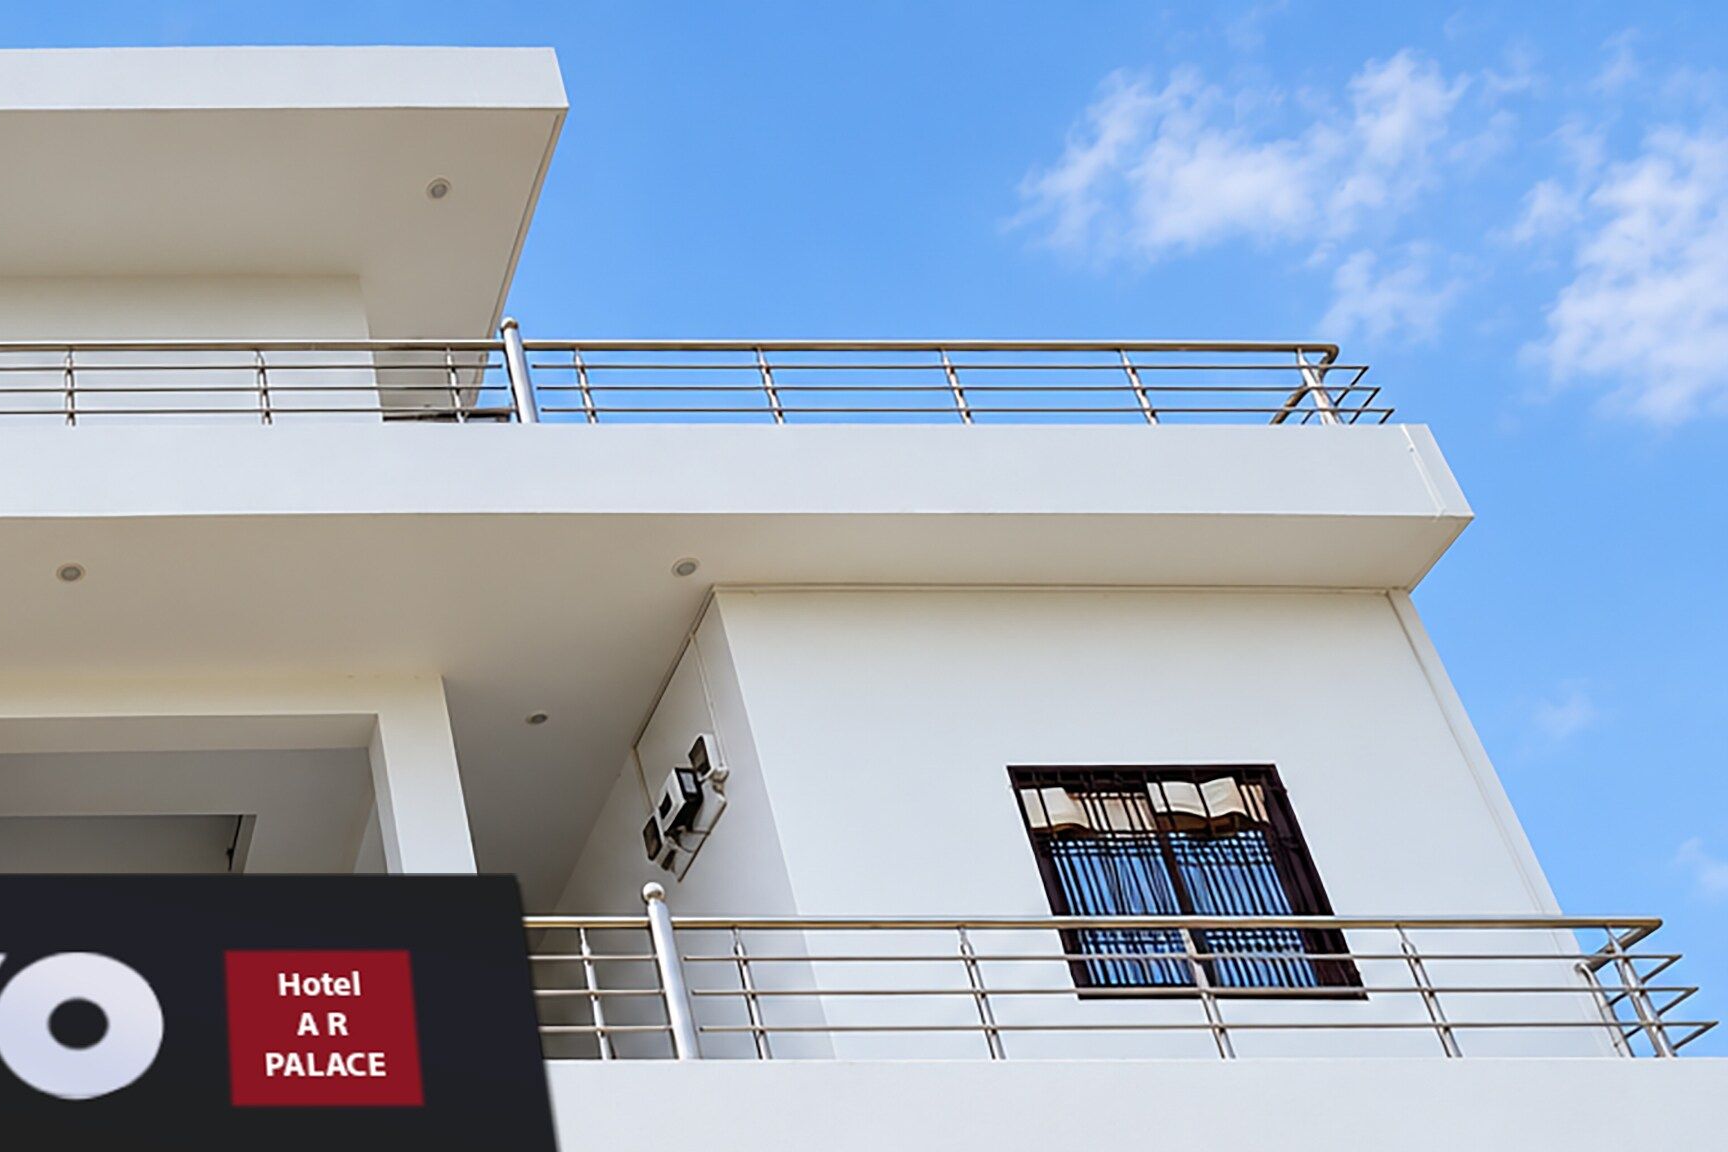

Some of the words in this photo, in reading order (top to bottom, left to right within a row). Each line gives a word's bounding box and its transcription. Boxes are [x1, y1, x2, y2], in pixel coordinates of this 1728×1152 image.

[278, 970, 362, 997] Hotel
[297, 1012, 320, 1037] A
[327, 1012, 349, 1037] R
[265, 1052, 388, 1078] PALACE
